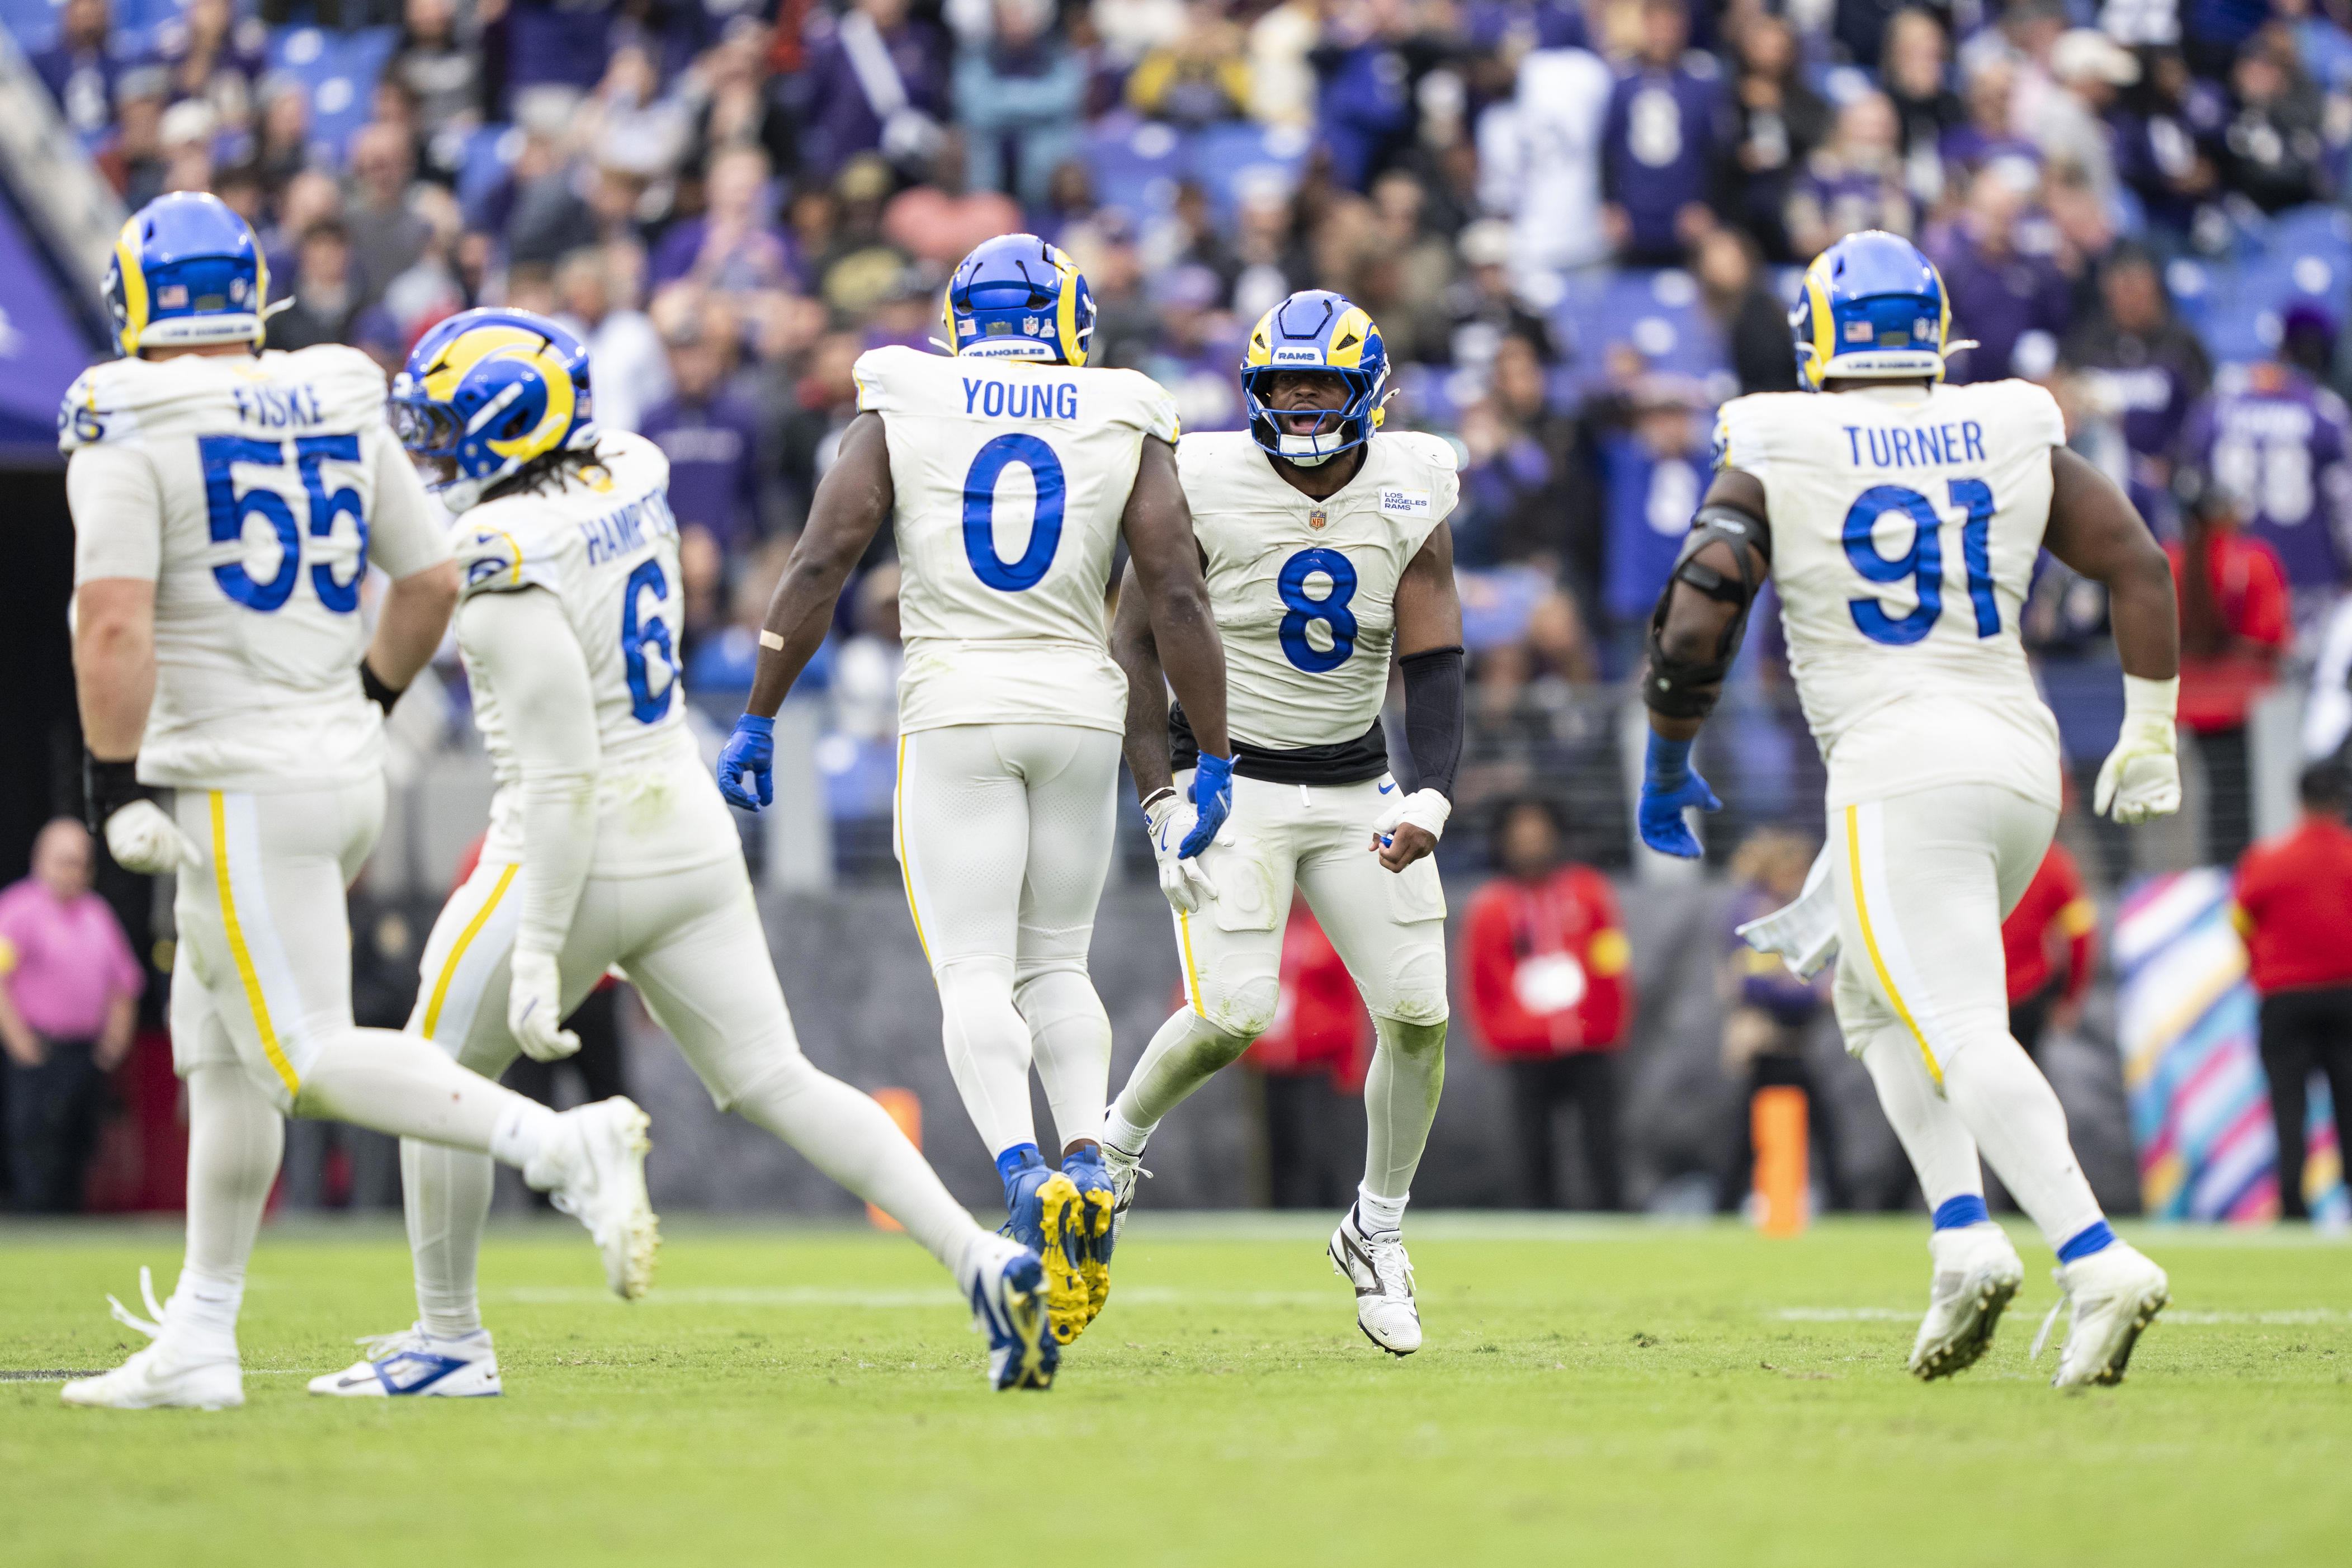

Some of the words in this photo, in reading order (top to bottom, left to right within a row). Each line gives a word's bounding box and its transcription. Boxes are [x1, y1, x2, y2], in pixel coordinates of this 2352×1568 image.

[985, 348, 1045, 356] ANGELES
[233, 385, 326, 428] FISKE
[962, 377, 1078, 420] YOUNG
[1844, 421, 1985, 467] TURNER
[199, 433, 369, 613] 55
[963, 433, 1065, 592] 0
[1312, 518, 1324, 526] NFL
[1385, 498, 1427, 506] ANGELES
[1843, 478, 2001, 645] 91
[1278, 548, 1358, 673] 8
[622, 559, 681, 724] 6
[1107, 1153, 1130, 1164] ALPHA
